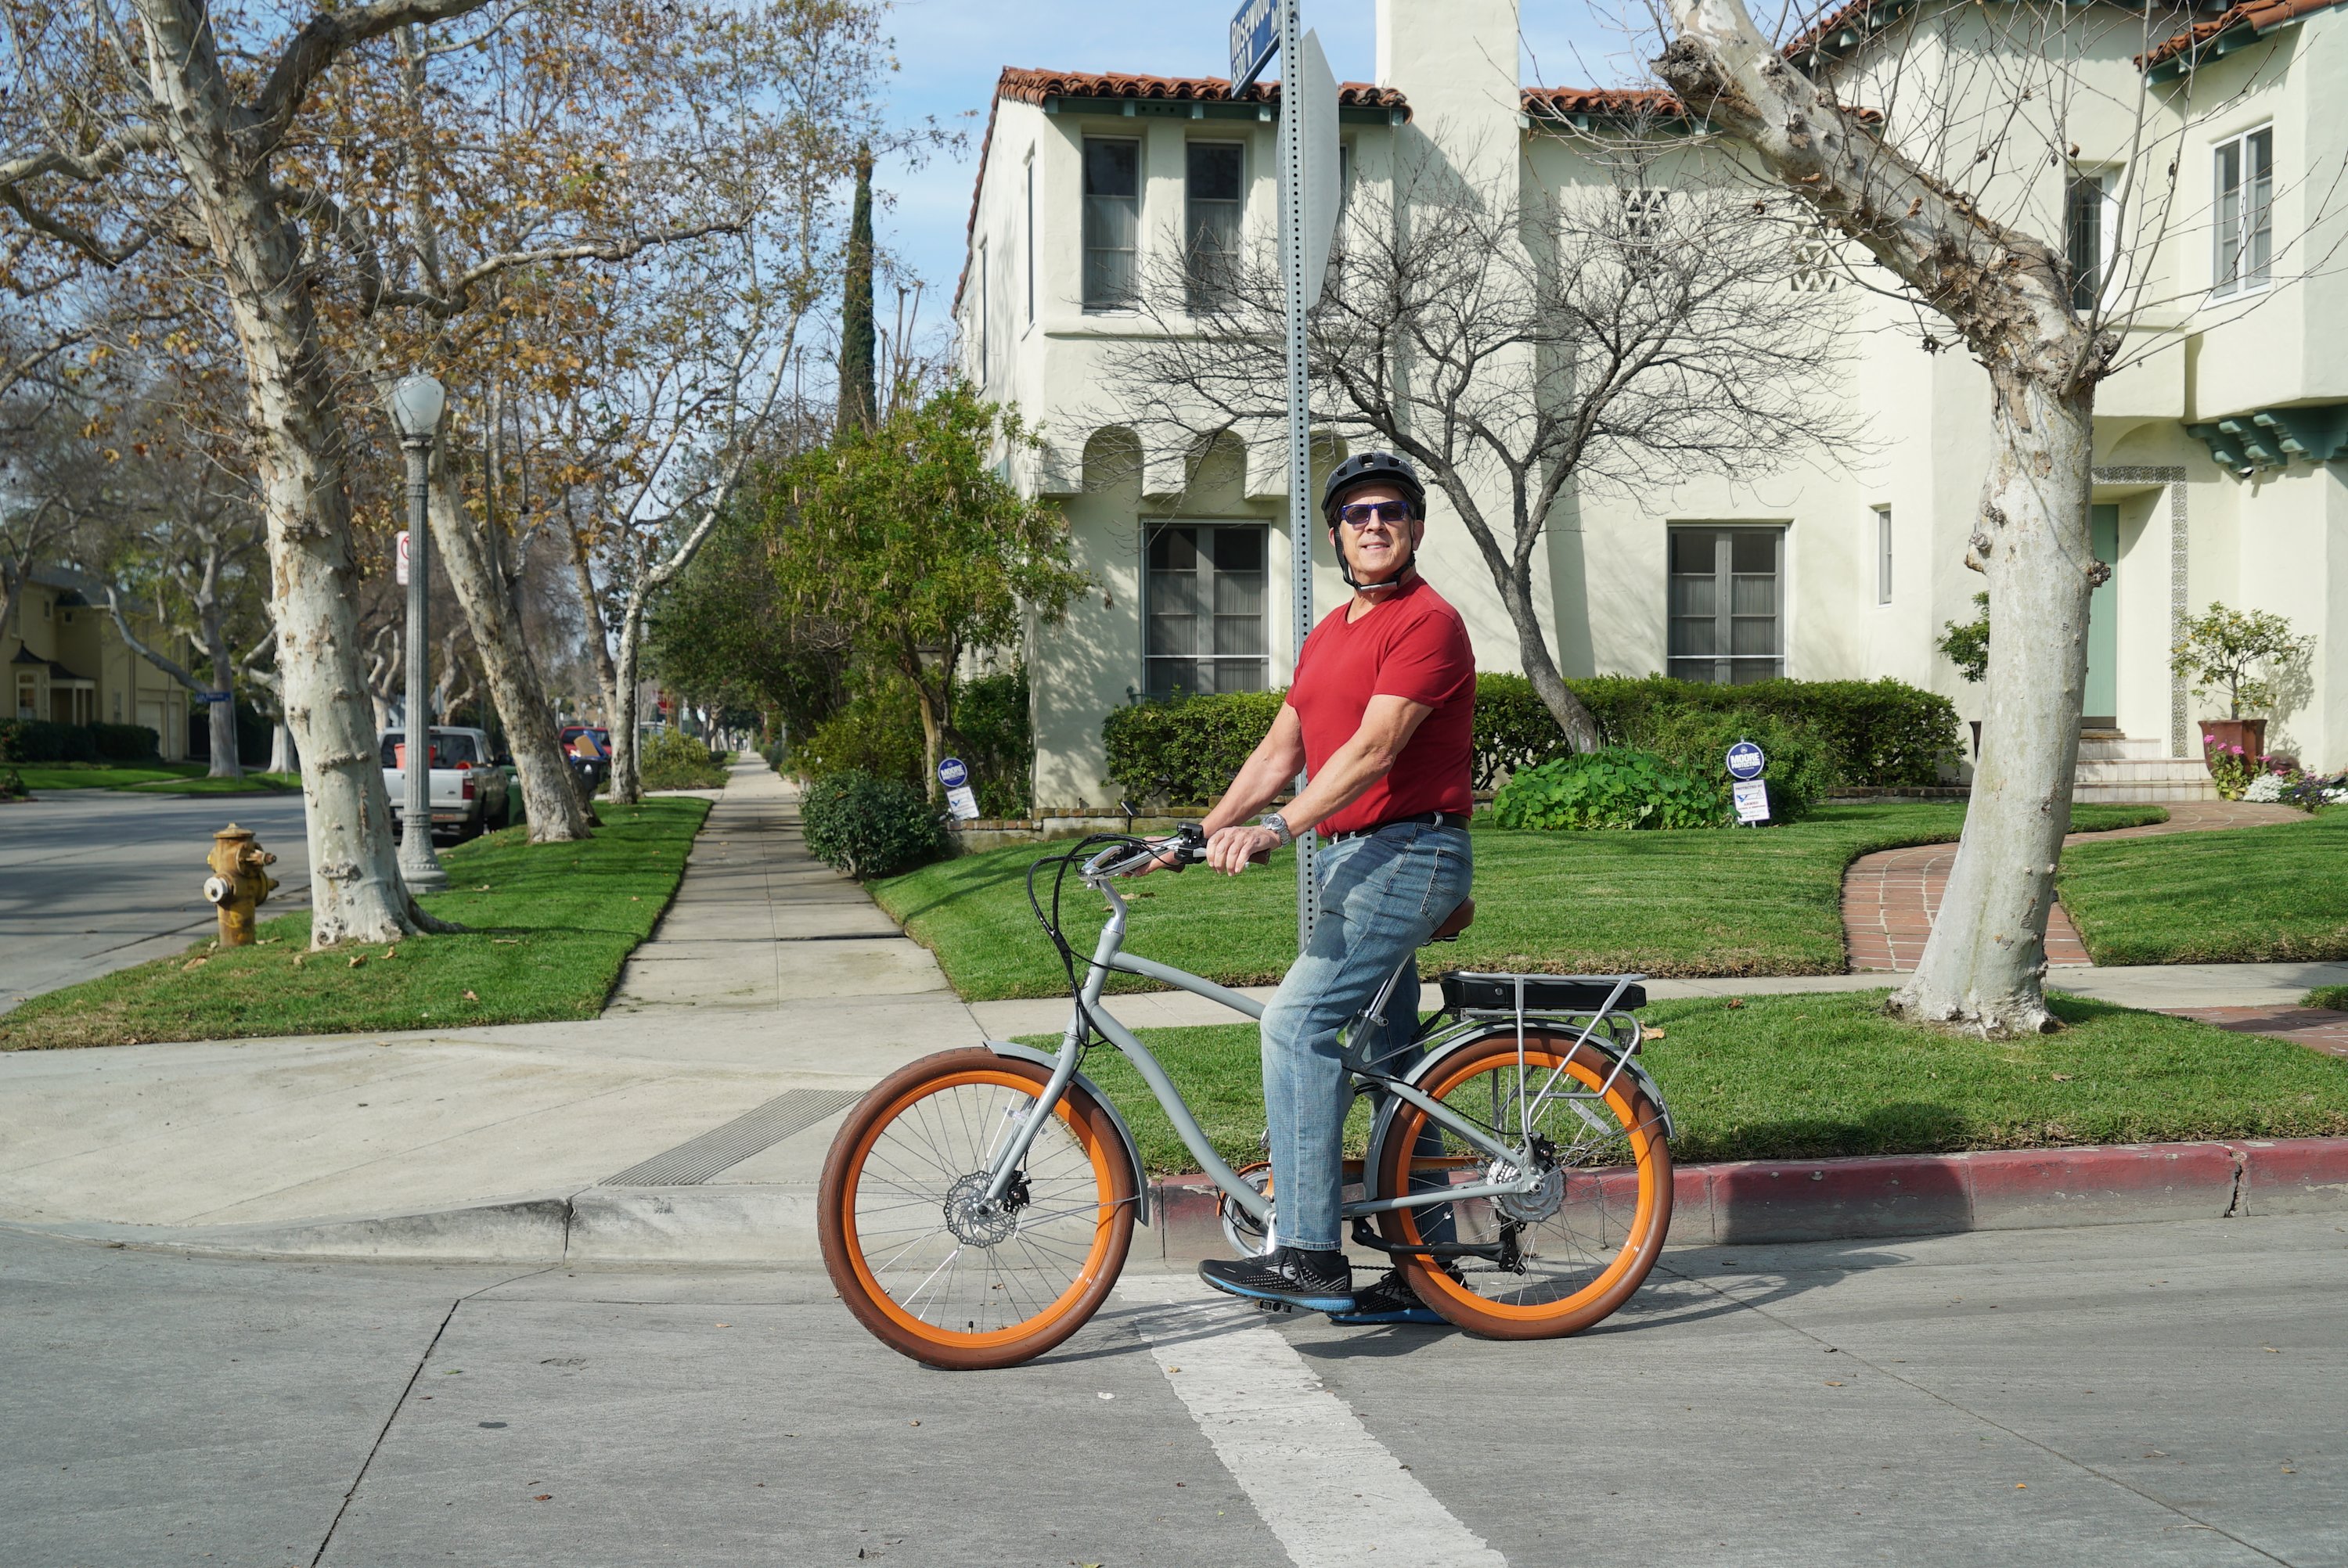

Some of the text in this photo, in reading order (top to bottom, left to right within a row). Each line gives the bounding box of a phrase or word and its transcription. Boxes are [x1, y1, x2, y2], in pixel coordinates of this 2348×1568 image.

[1270, 6, 1280, 37] Av
[1232, 37, 1252, 89] 6300 W
[1730, 752, 1760, 764] MOORE
